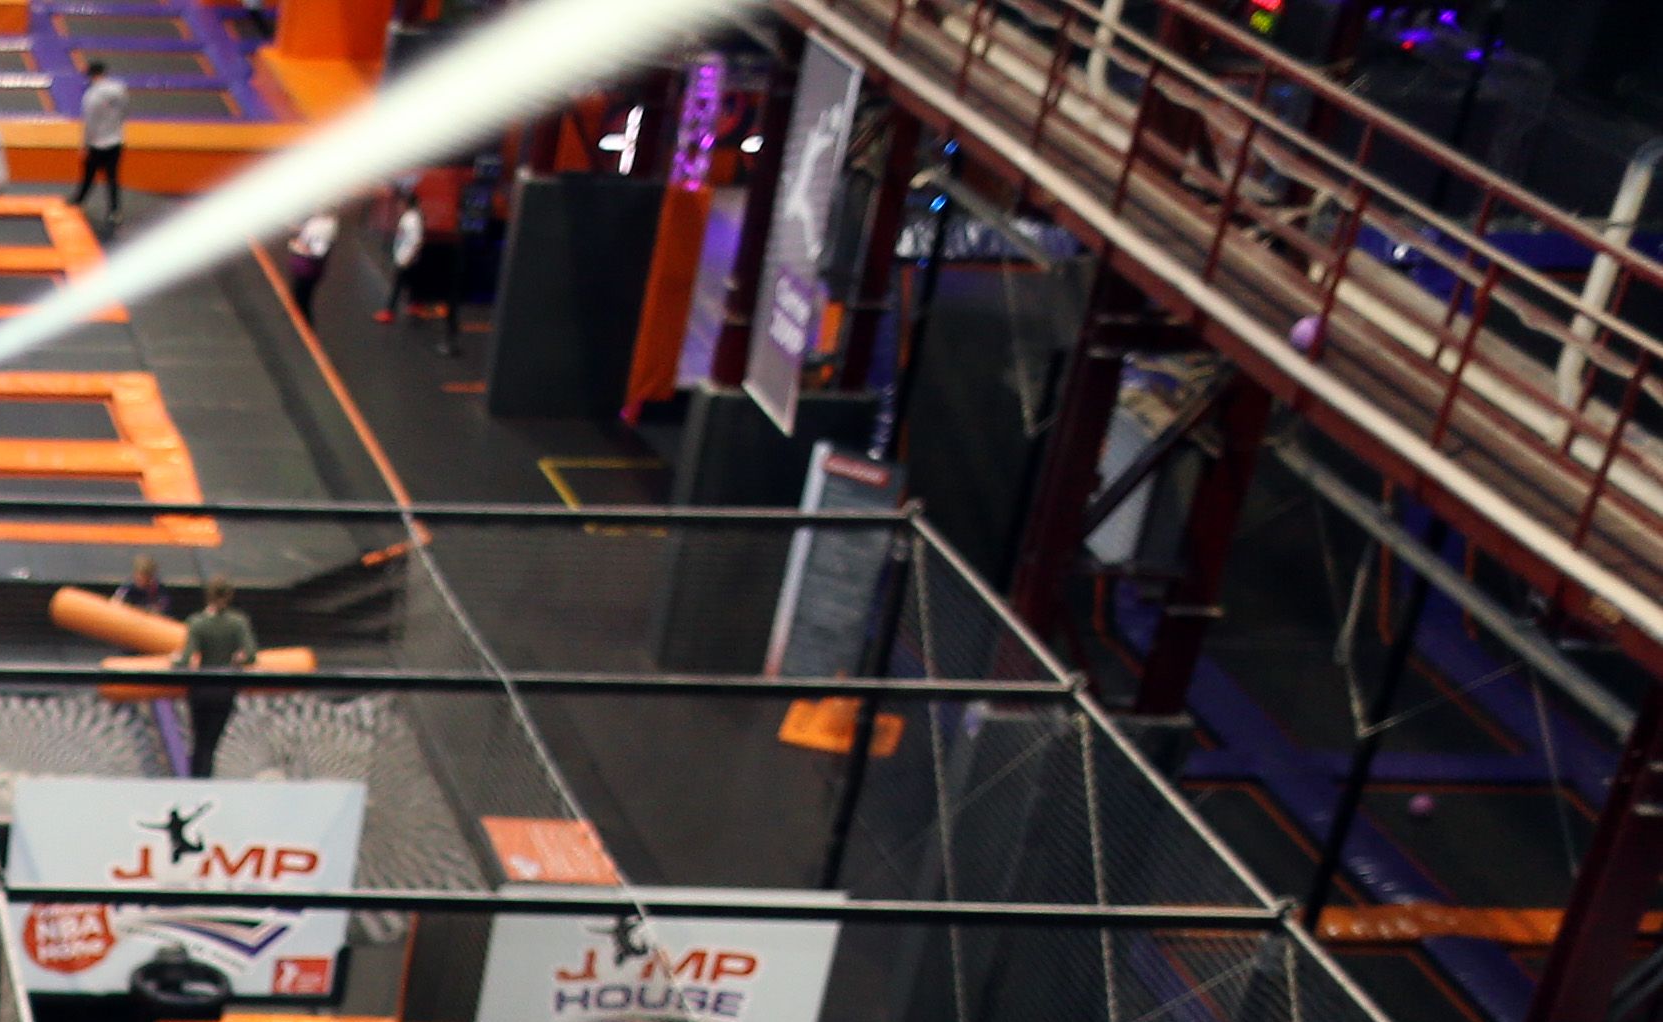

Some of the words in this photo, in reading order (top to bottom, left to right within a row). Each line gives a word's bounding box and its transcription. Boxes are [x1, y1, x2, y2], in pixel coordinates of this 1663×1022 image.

[112, 846, 319, 880] JMP
[554, 949, 758, 981] JMP
[554, 985, 744, 1017] HOUSE
